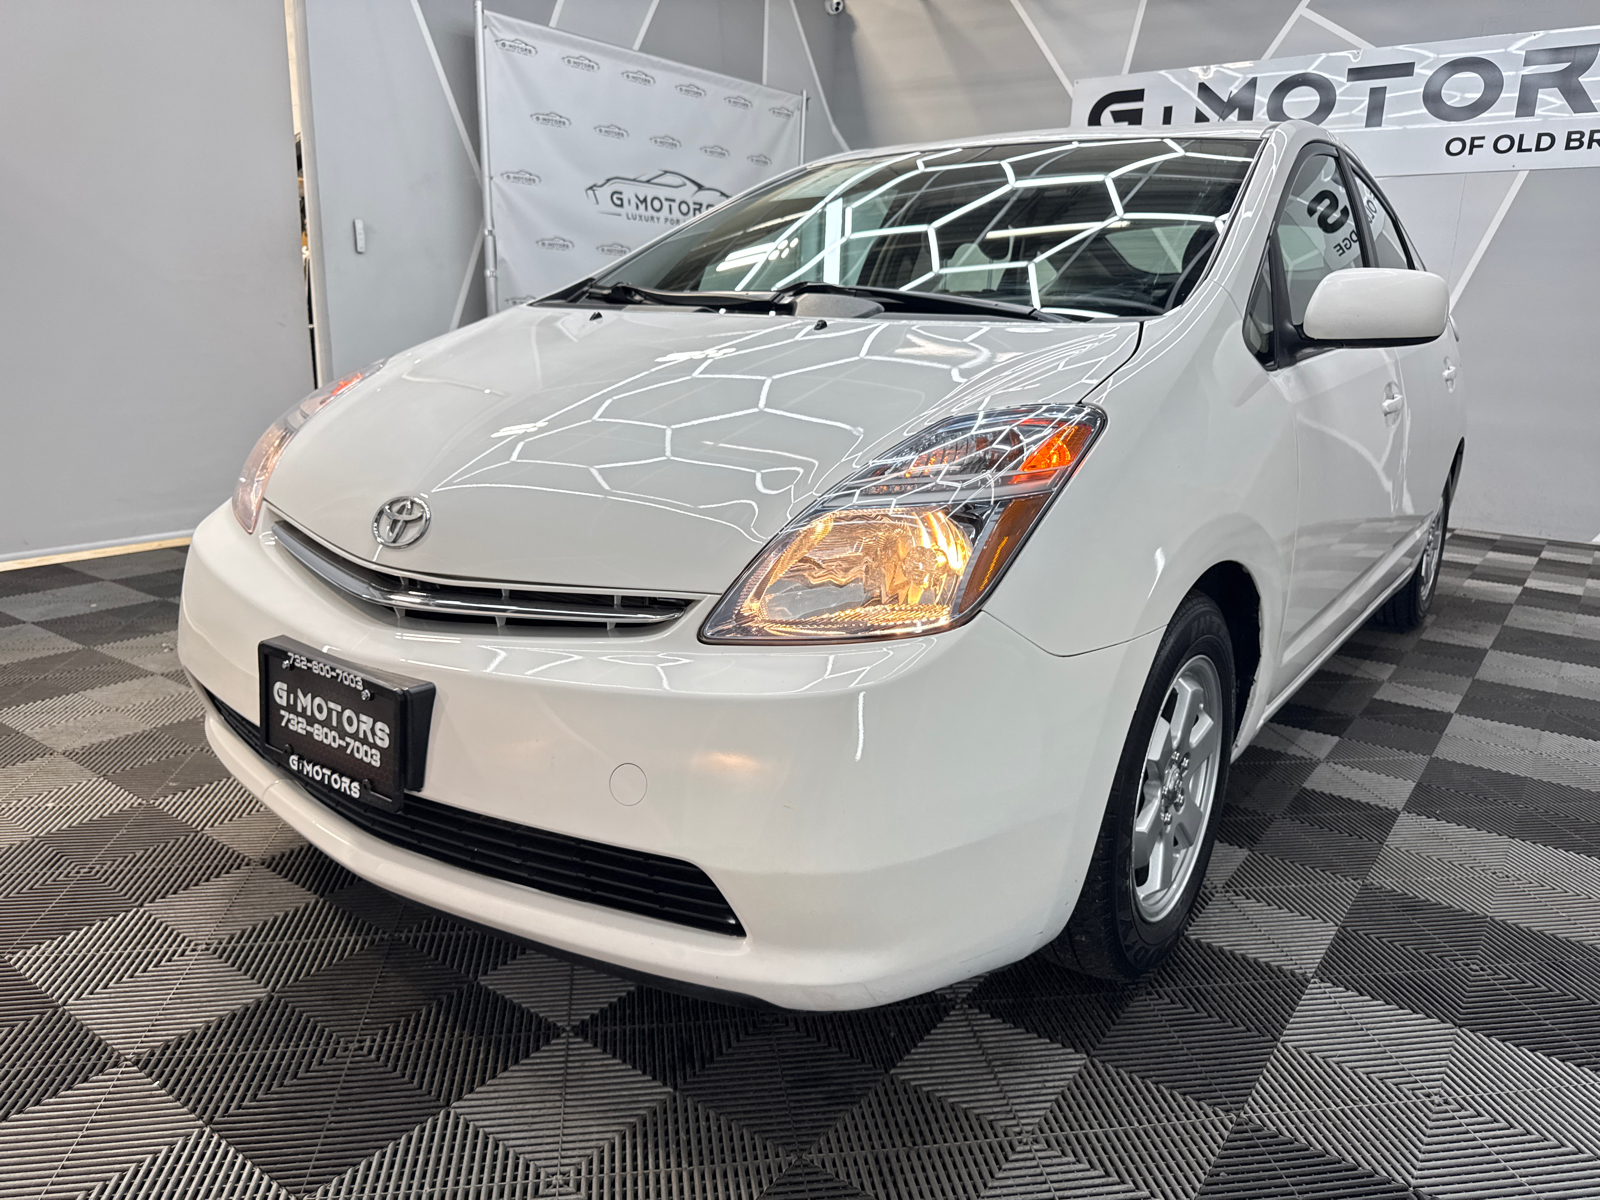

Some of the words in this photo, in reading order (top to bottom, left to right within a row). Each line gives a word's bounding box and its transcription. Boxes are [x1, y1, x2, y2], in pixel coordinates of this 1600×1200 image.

[1444, 135, 1486, 157] OF
[1492, 132, 1556, 154] OLD
[625, 212, 661, 224] LUXURY
[287, 652, 364, 691] 732-800-7003
[279, 709, 381, 768] 732-800-7003
